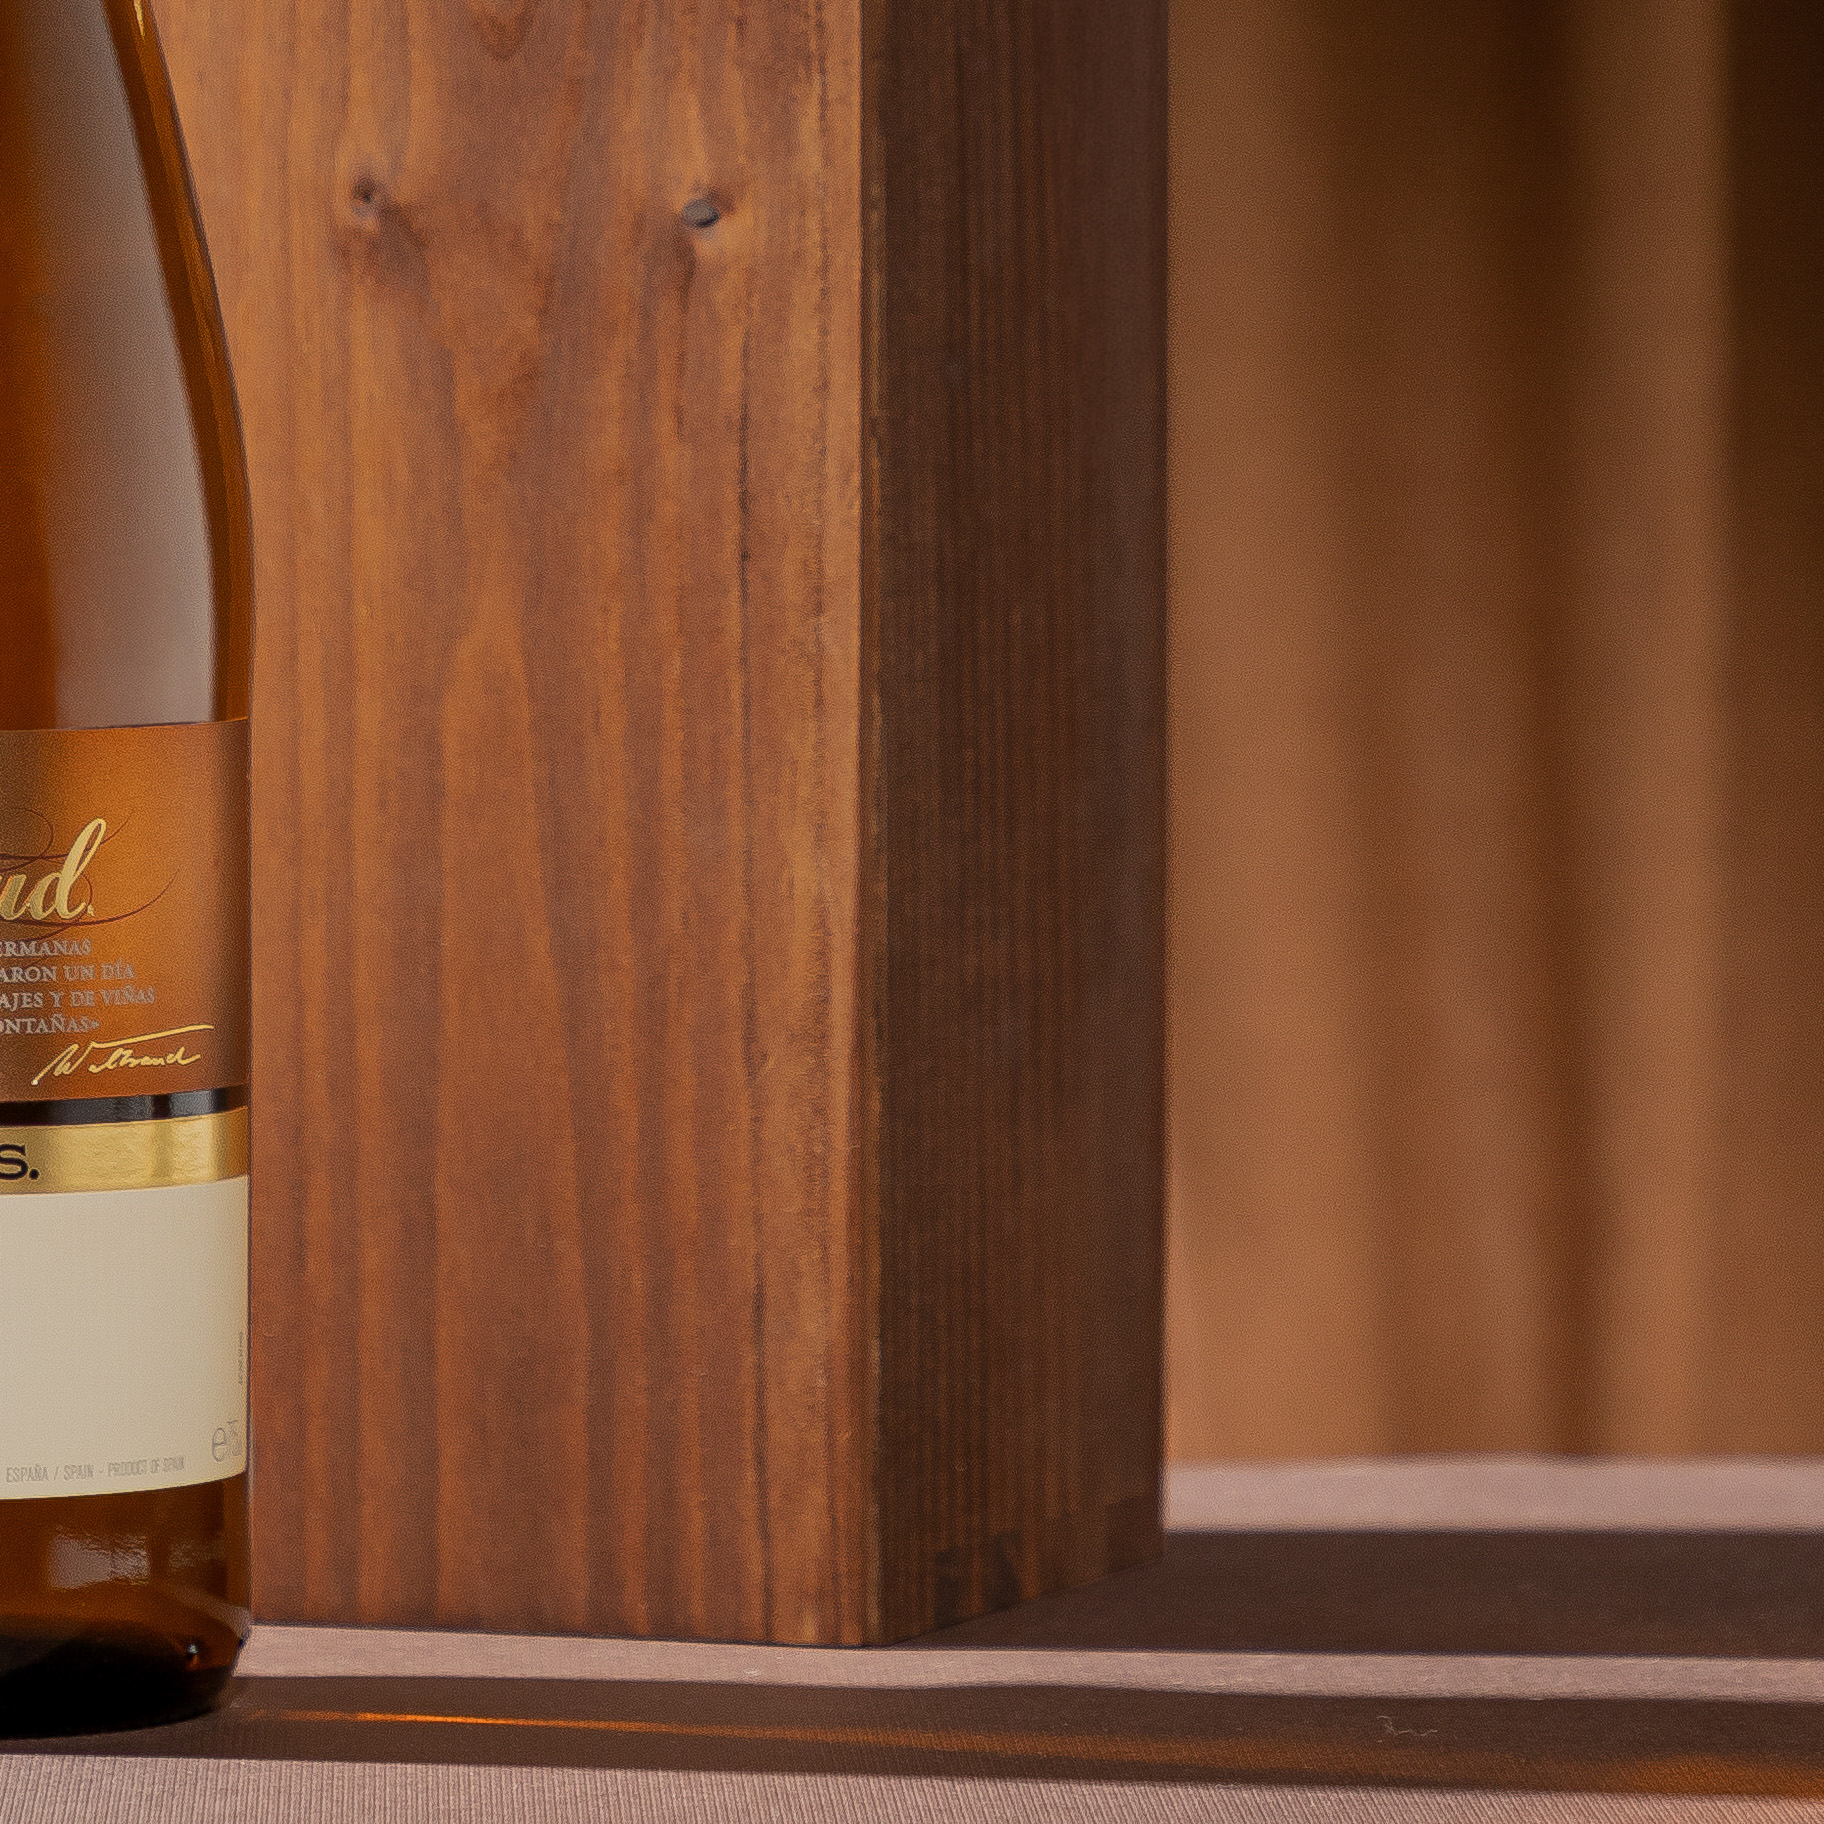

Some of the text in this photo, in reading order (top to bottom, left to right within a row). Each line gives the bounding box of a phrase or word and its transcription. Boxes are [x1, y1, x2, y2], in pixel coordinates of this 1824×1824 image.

[63, 964, 94, 982] UN
[100, 959, 135, 980] DÍA
[49, 991, 65, 1008] Y
[70, 990, 96, 1007] DE
[101, 985, 156, 1005] VIÑAS
[5, 1463, 51, 1484] ESPAÑA
[62, 1464, 95, 1482] SPAIN
